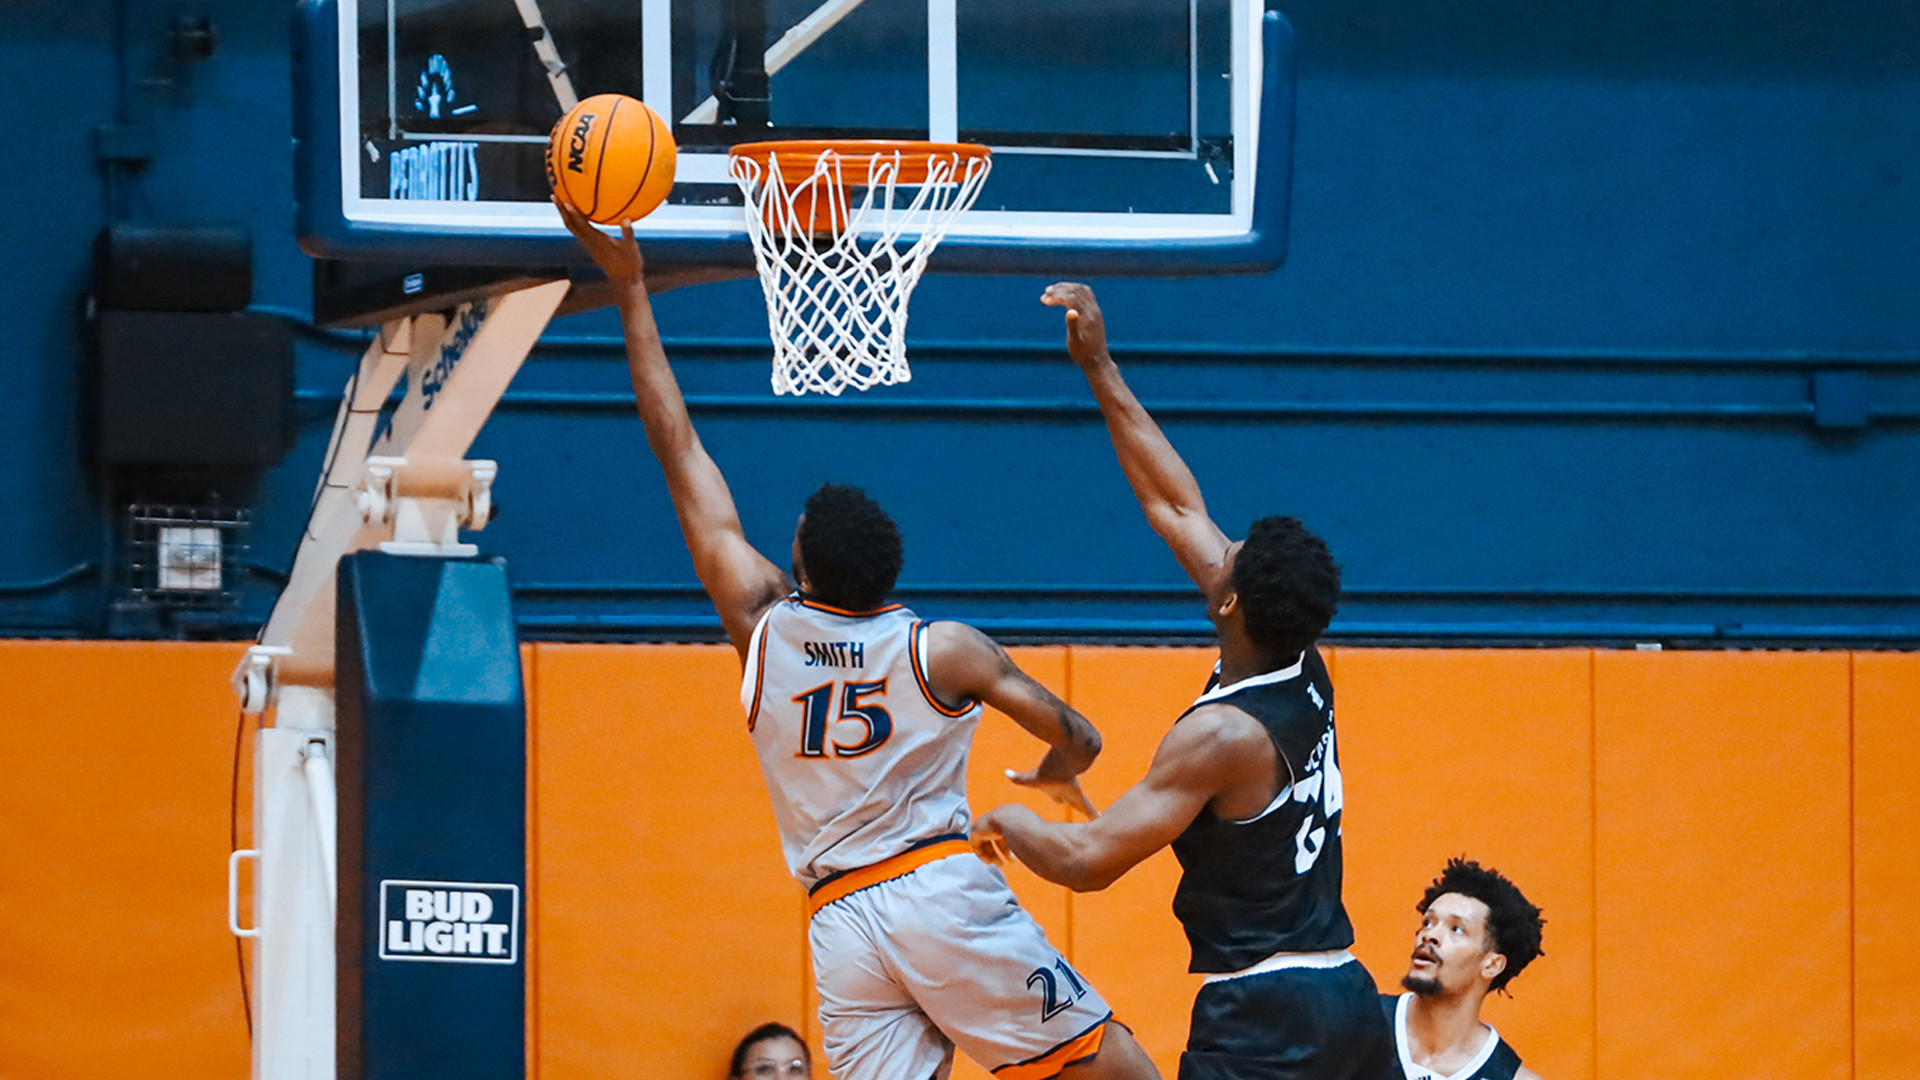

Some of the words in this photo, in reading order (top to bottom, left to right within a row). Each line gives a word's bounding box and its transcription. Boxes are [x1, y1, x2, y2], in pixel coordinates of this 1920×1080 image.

[568, 114, 595, 173] NCAA
[804, 641, 864, 668] SMITH
[790, 676, 894, 760] 15
[405, 889, 494, 922] BUD
[388, 920, 509, 955] LIGHT
[1026, 957, 1087, 1024] 21
